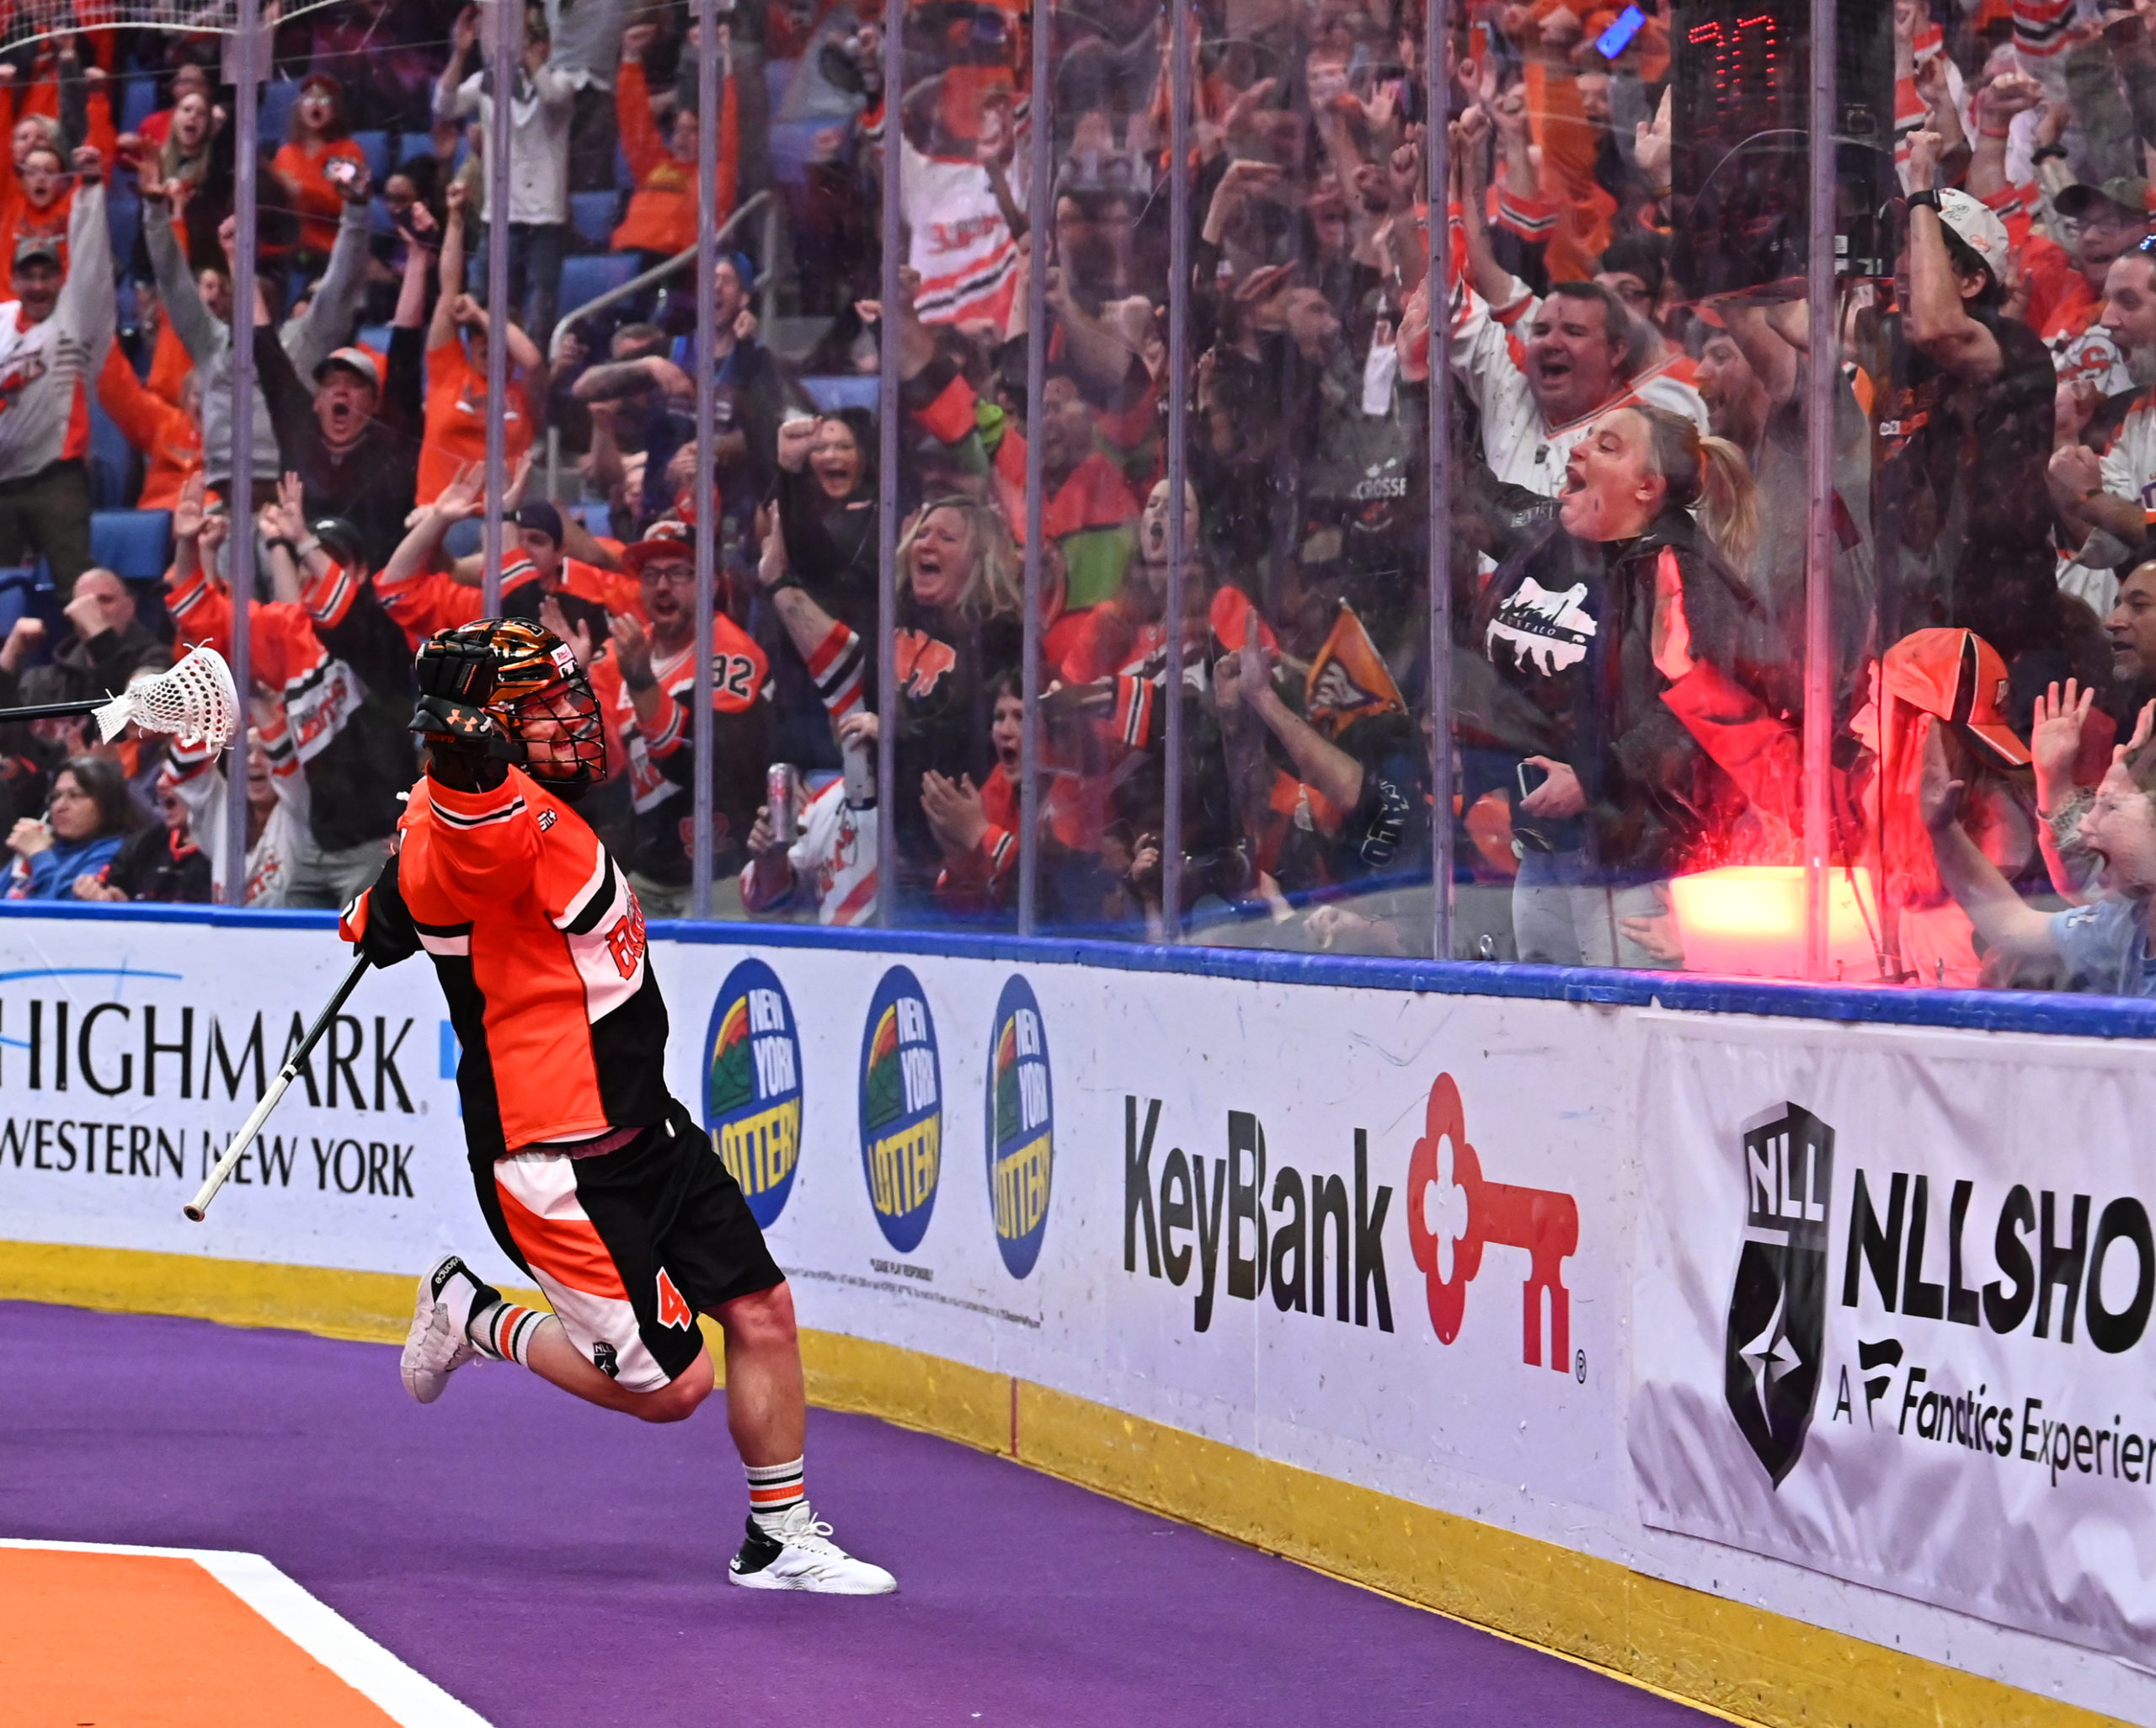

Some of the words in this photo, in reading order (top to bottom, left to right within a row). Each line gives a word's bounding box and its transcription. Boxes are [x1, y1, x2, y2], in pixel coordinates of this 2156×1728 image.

[748, 988, 785, 1035] NEW
[896, 996, 926, 1045] NEW
[1014, 1008, 1041, 1058] NEW
[0, 997, 414, 1114] HIGHMARK
[752, 1035, 797, 1101] YORK
[899, 1046, 937, 1114] YORK
[0, 1116, 184, 1179] WESTERN
[201, 1129, 297, 1187] NEW
[311, 1137, 414, 1198] YORK
[867, 1110, 941, 1217] LOTTERY
[993, 1128, 1052, 1240] LOTTERY
[1748, 1132, 1825, 1221] NLL
[1123, 1094, 1396, 1334] KeyBank
[655, 1266, 692, 1332] 4
[1842, 1167, 2155, 1354] NLLSHO
[1833, 1364, 1853, 1424] A
[1898, 1366, 2014, 1458] Fanatics
